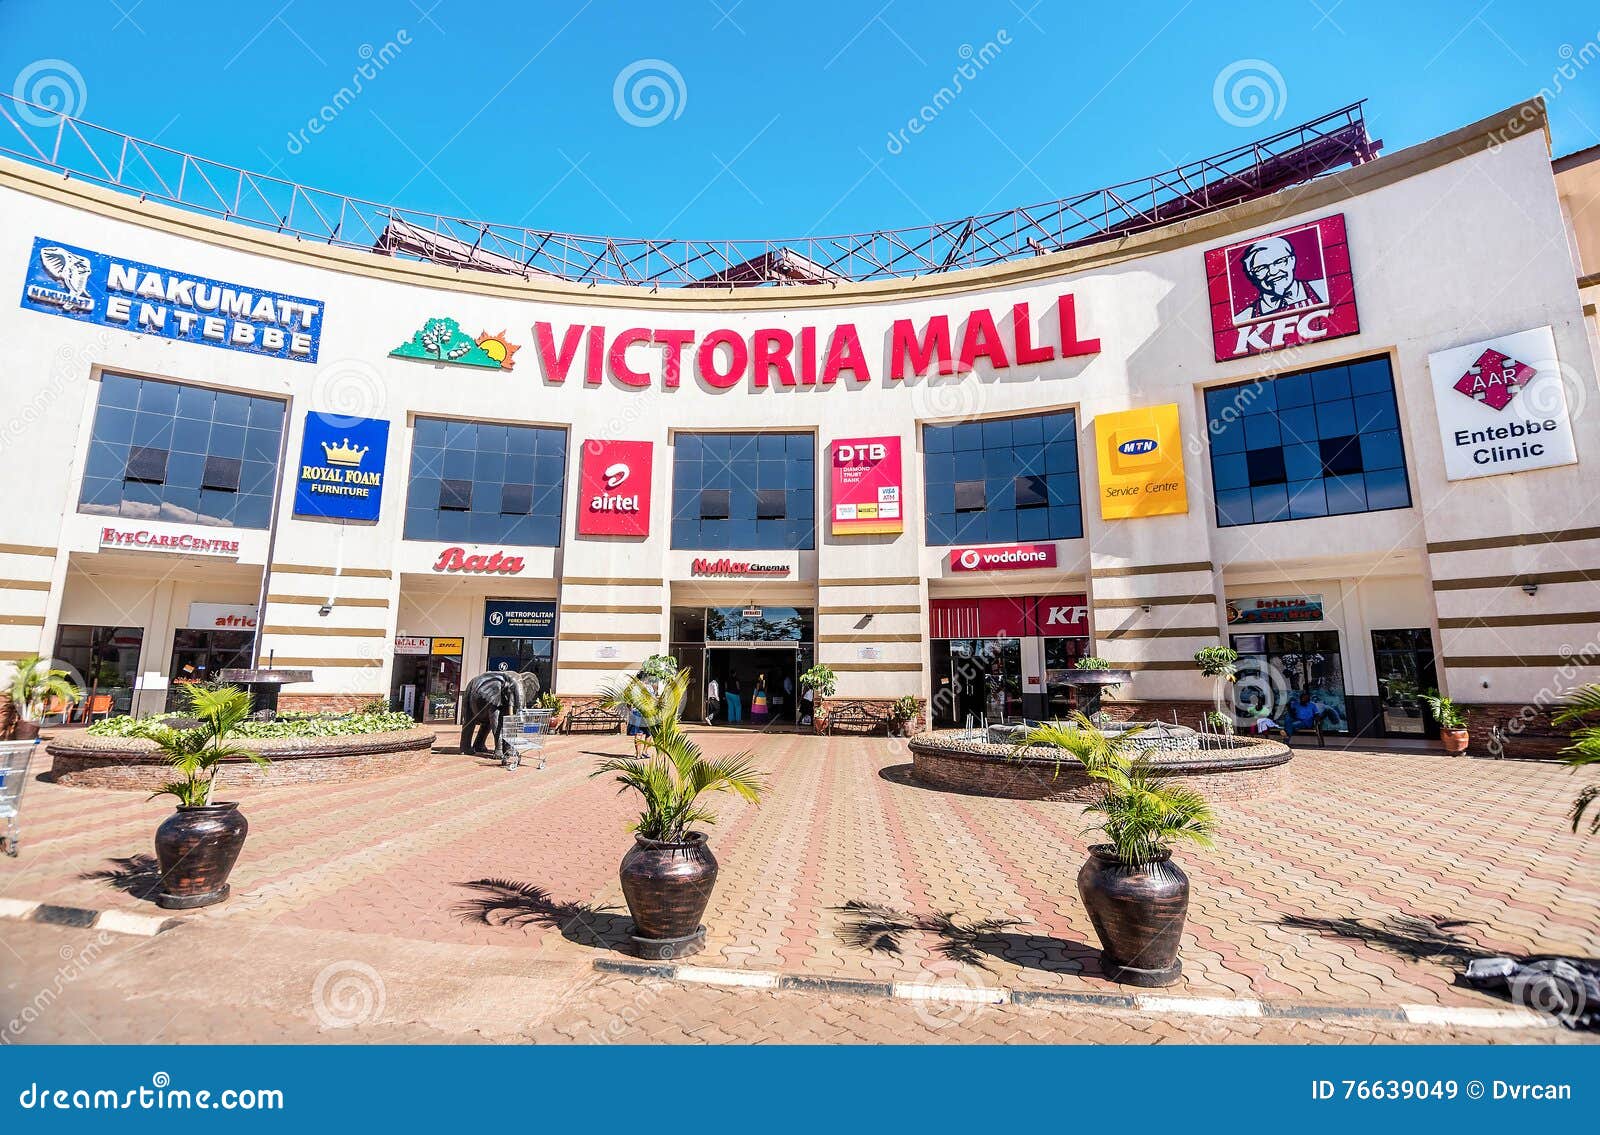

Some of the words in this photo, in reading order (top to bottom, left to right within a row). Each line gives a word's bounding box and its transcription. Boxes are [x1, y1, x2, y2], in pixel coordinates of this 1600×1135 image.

[107, 263, 318, 328] NAKUMATT
[106, 296, 312, 354] ENTEBBE
[1232, 309, 1330, 355] KFC
[535, 321, 871, 387] VICTORIA
[891, 294, 1100, 379] MALL
[1473, 368, 1517, 390] AAR
[1454, 419, 1557, 446] Entebbe
[838, 444, 886, 462] DTB
[1124, 441, 1152, 453] MTN
[1473, 442, 1544, 464] Clinic
[302, 466, 342, 482] ROYAL
[345, 470, 381, 485] FOAM
[311, 484, 369, 497] FURNITURE
[1106, 486, 1139, 497] Service
[1145, 483, 1178, 493] Centre
[592, 492, 639, 511] airtel
[434, 547, 525, 573] Bata
[693, 558, 750, 573] NuMax
[750, 563, 790, 571] Cinemas
[983, 551, 1046, 563] vodafone
[215, 615, 257, 627] afric
[1046, 606, 1089, 624] KF
